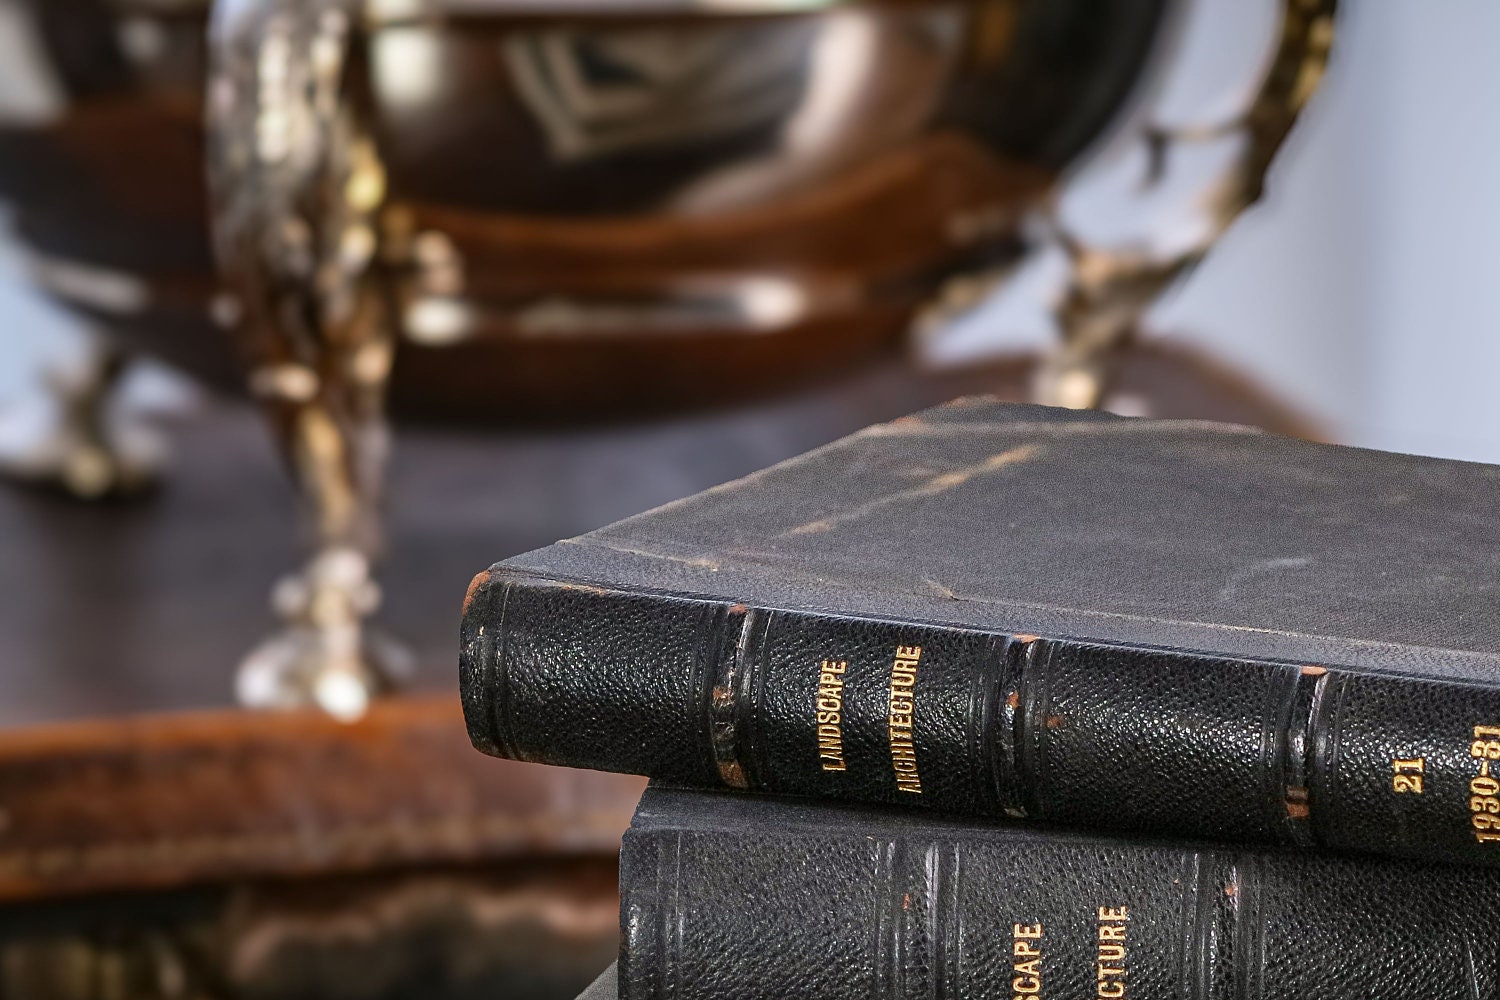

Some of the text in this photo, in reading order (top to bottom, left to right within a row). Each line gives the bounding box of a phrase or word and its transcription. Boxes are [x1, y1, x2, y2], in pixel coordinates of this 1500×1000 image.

[817, 660, 847, 771] LANDSCAPE
[889, 645, 923, 793] ARCHITECTURE
[1392, 758, 1425, 793] 21
